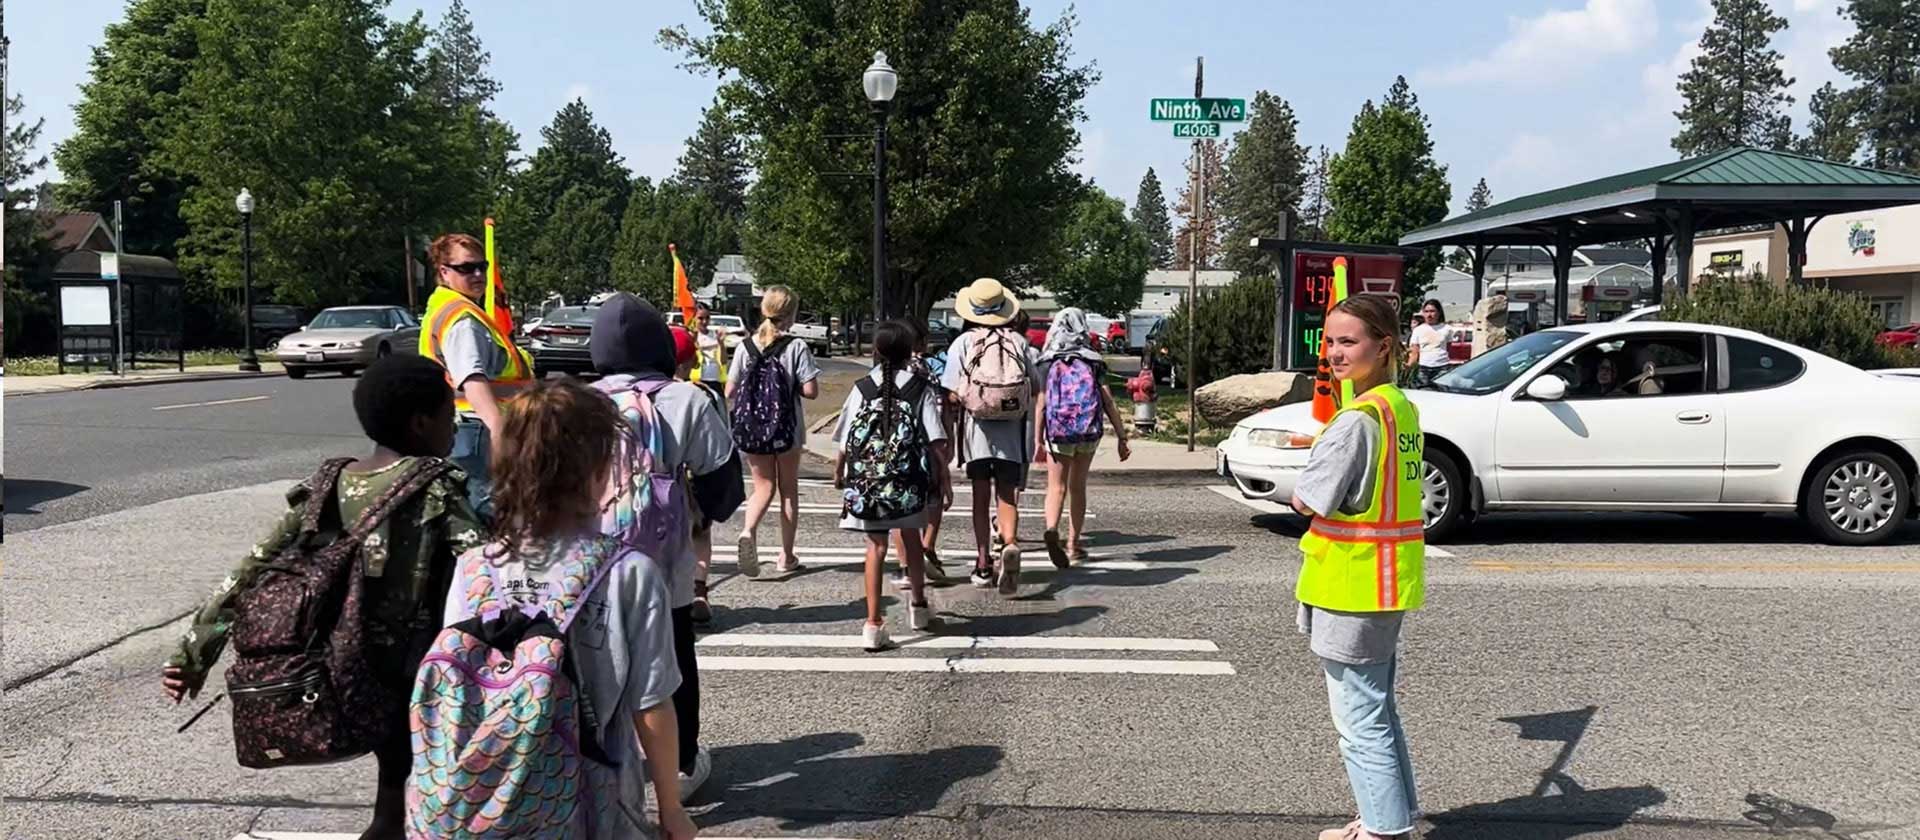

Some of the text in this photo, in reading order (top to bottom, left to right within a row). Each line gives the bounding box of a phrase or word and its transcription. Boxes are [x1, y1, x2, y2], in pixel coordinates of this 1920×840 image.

[1155, 101, 1241, 119] Ninth Ave
[1177, 124, 1216, 136] 1400E
